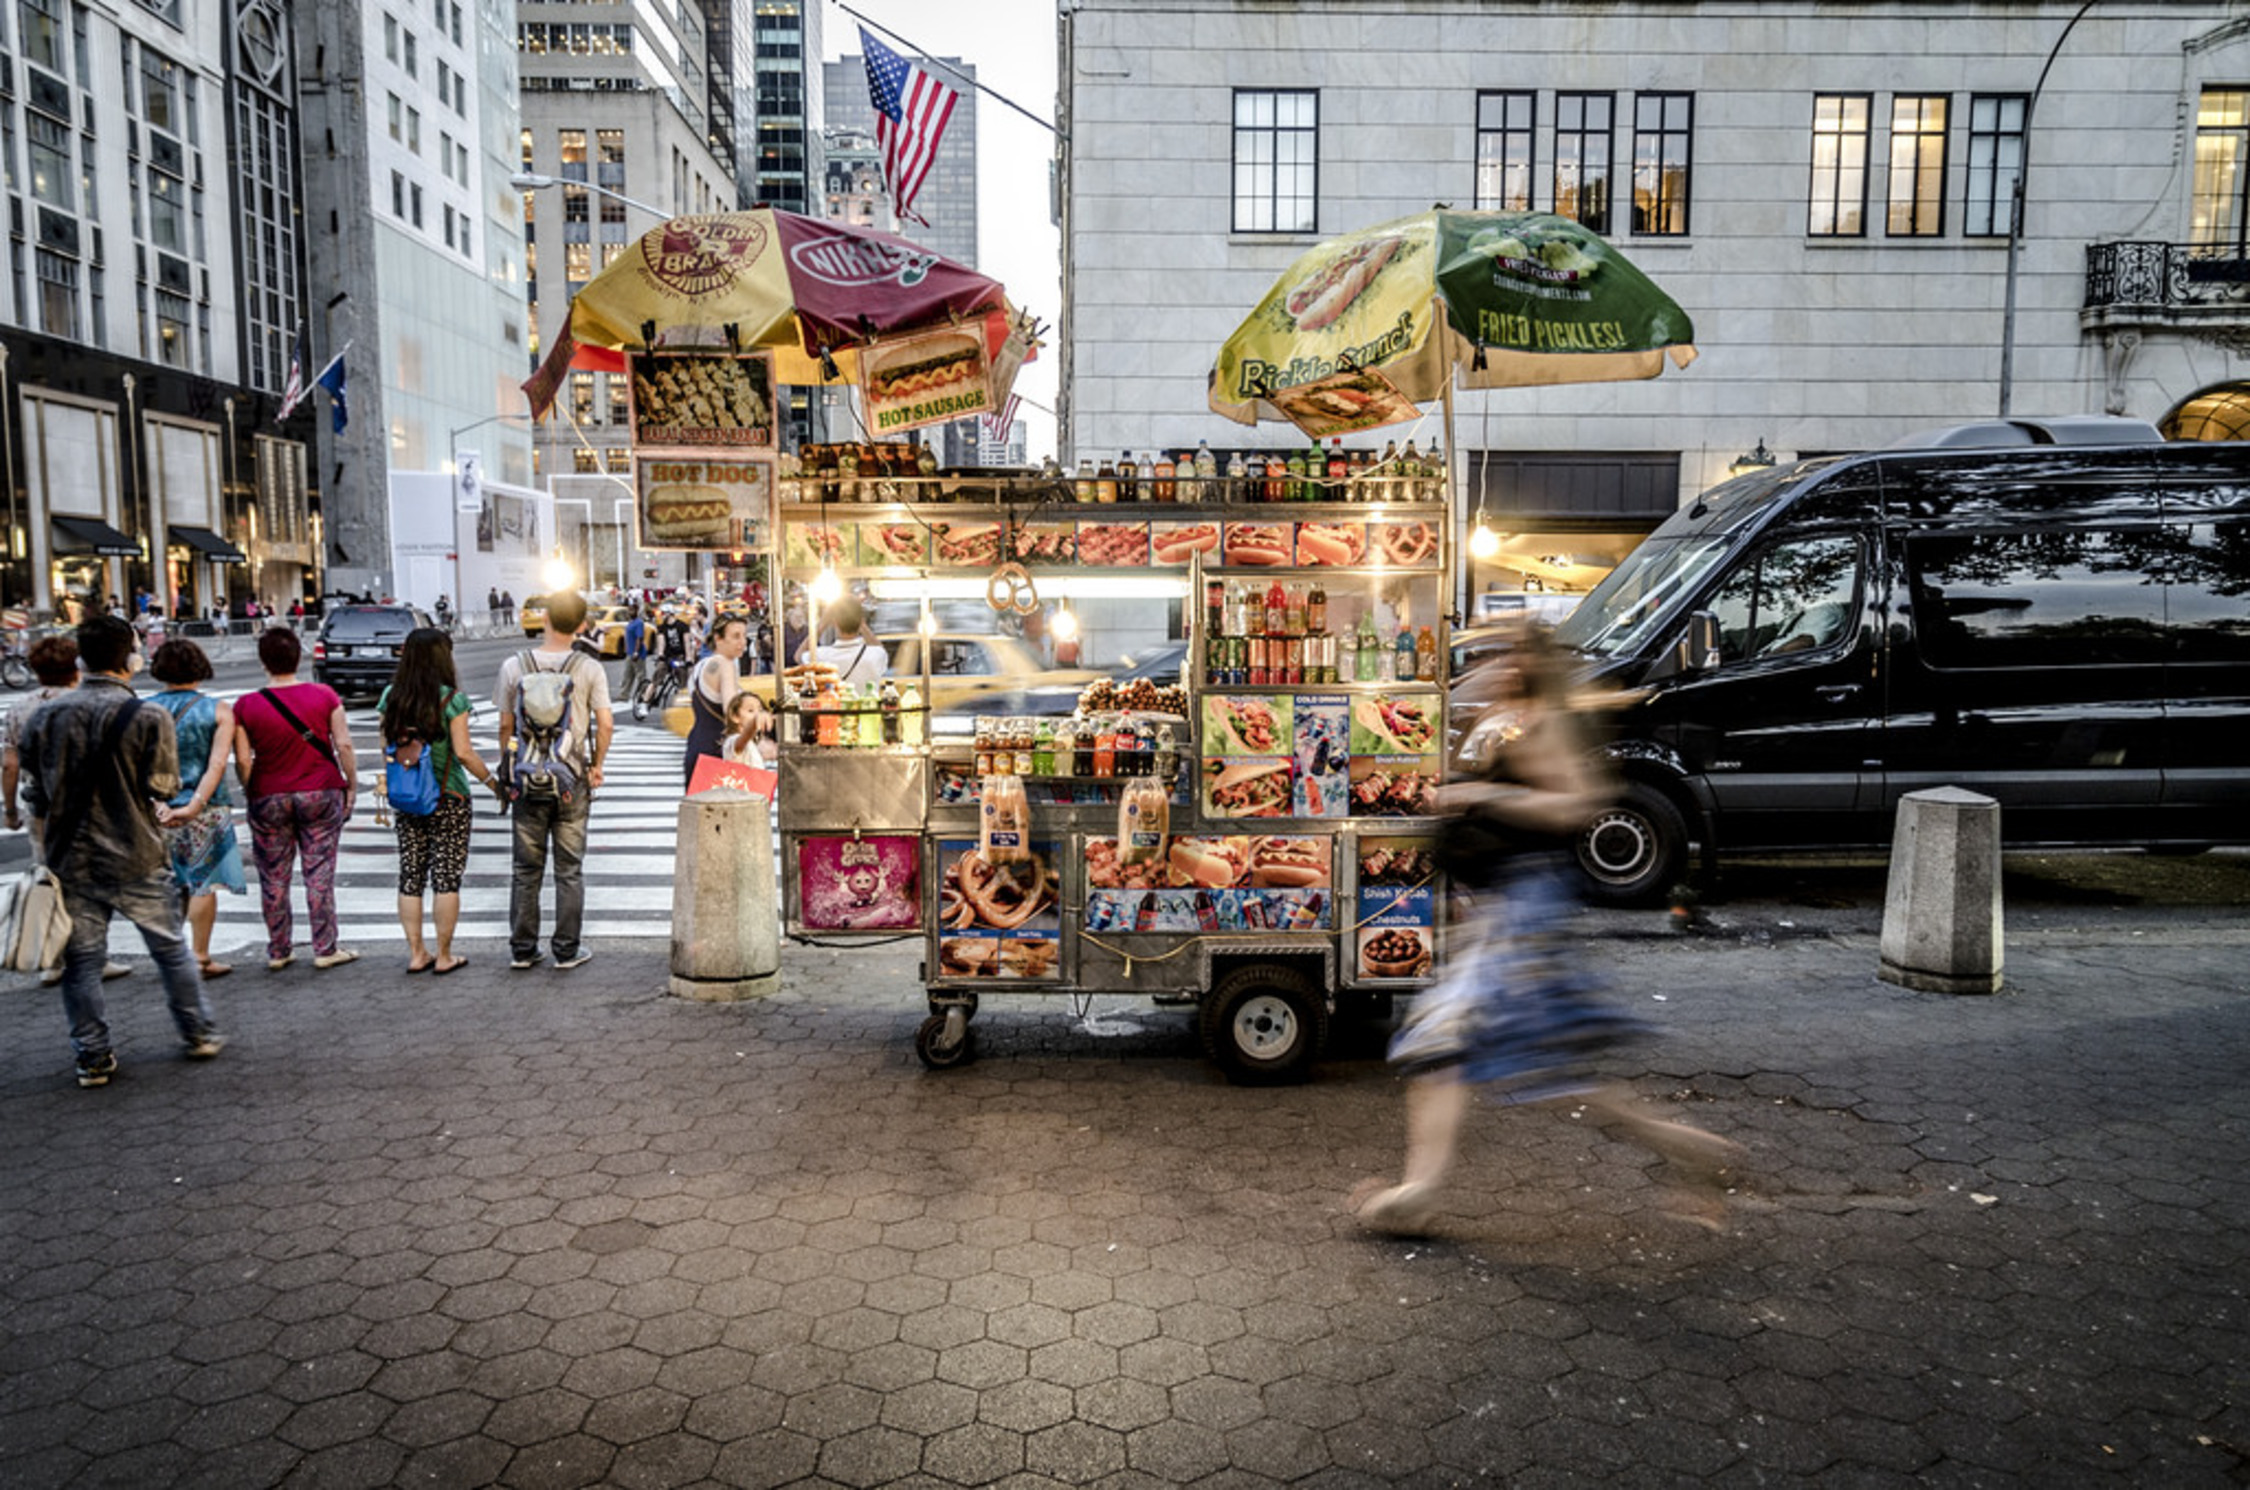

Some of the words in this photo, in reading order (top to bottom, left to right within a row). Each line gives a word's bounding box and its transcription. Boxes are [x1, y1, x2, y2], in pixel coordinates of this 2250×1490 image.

[670, 219, 760, 241] GOLDEN
[1478, 308, 1531, 346] FRIED
[1533, 319, 1626, 349] PICKLES!
[878, 406, 912, 429] HOT
[913, 389, 986, 420] SAUSAGE
[650, 463, 703, 483] HOT
[706, 465, 760, 484] DOG
[1296, 695, 1318, 704] COLD
[1319, 695, 1348, 704] DRINKS
[1363, 887, 1393, 900] Shish
